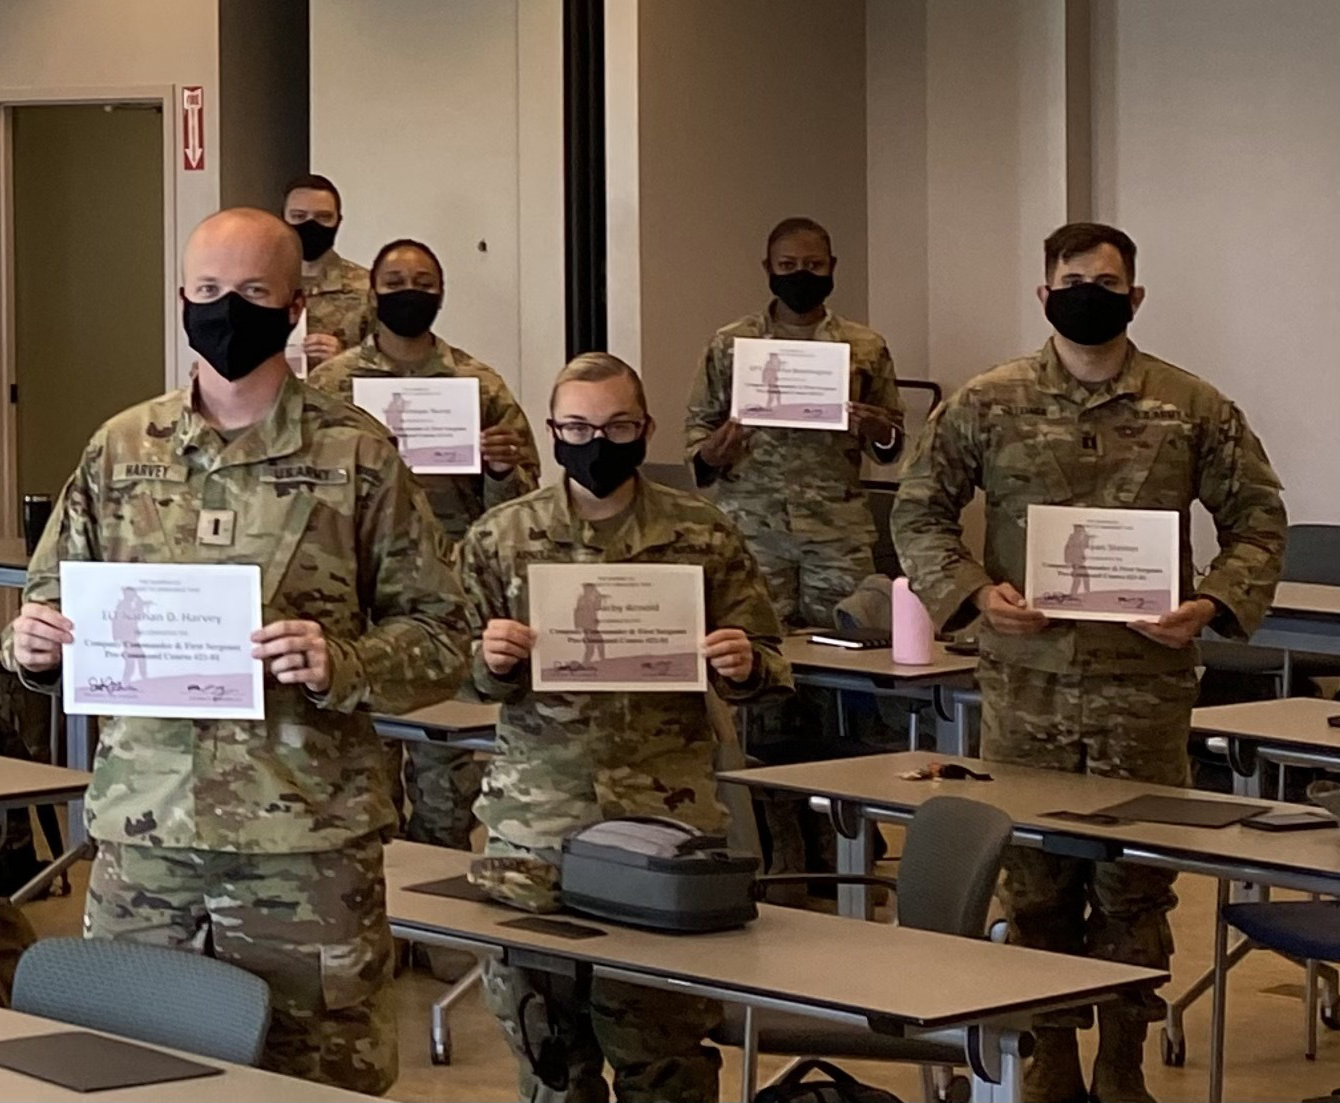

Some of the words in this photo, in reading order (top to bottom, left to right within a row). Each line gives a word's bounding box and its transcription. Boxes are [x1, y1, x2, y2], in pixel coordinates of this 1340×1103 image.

[126, 464, 168, 479] HARVEY
[296, 467, 330, 481] ARMY
[181, 612, 222, 625] Harvey
